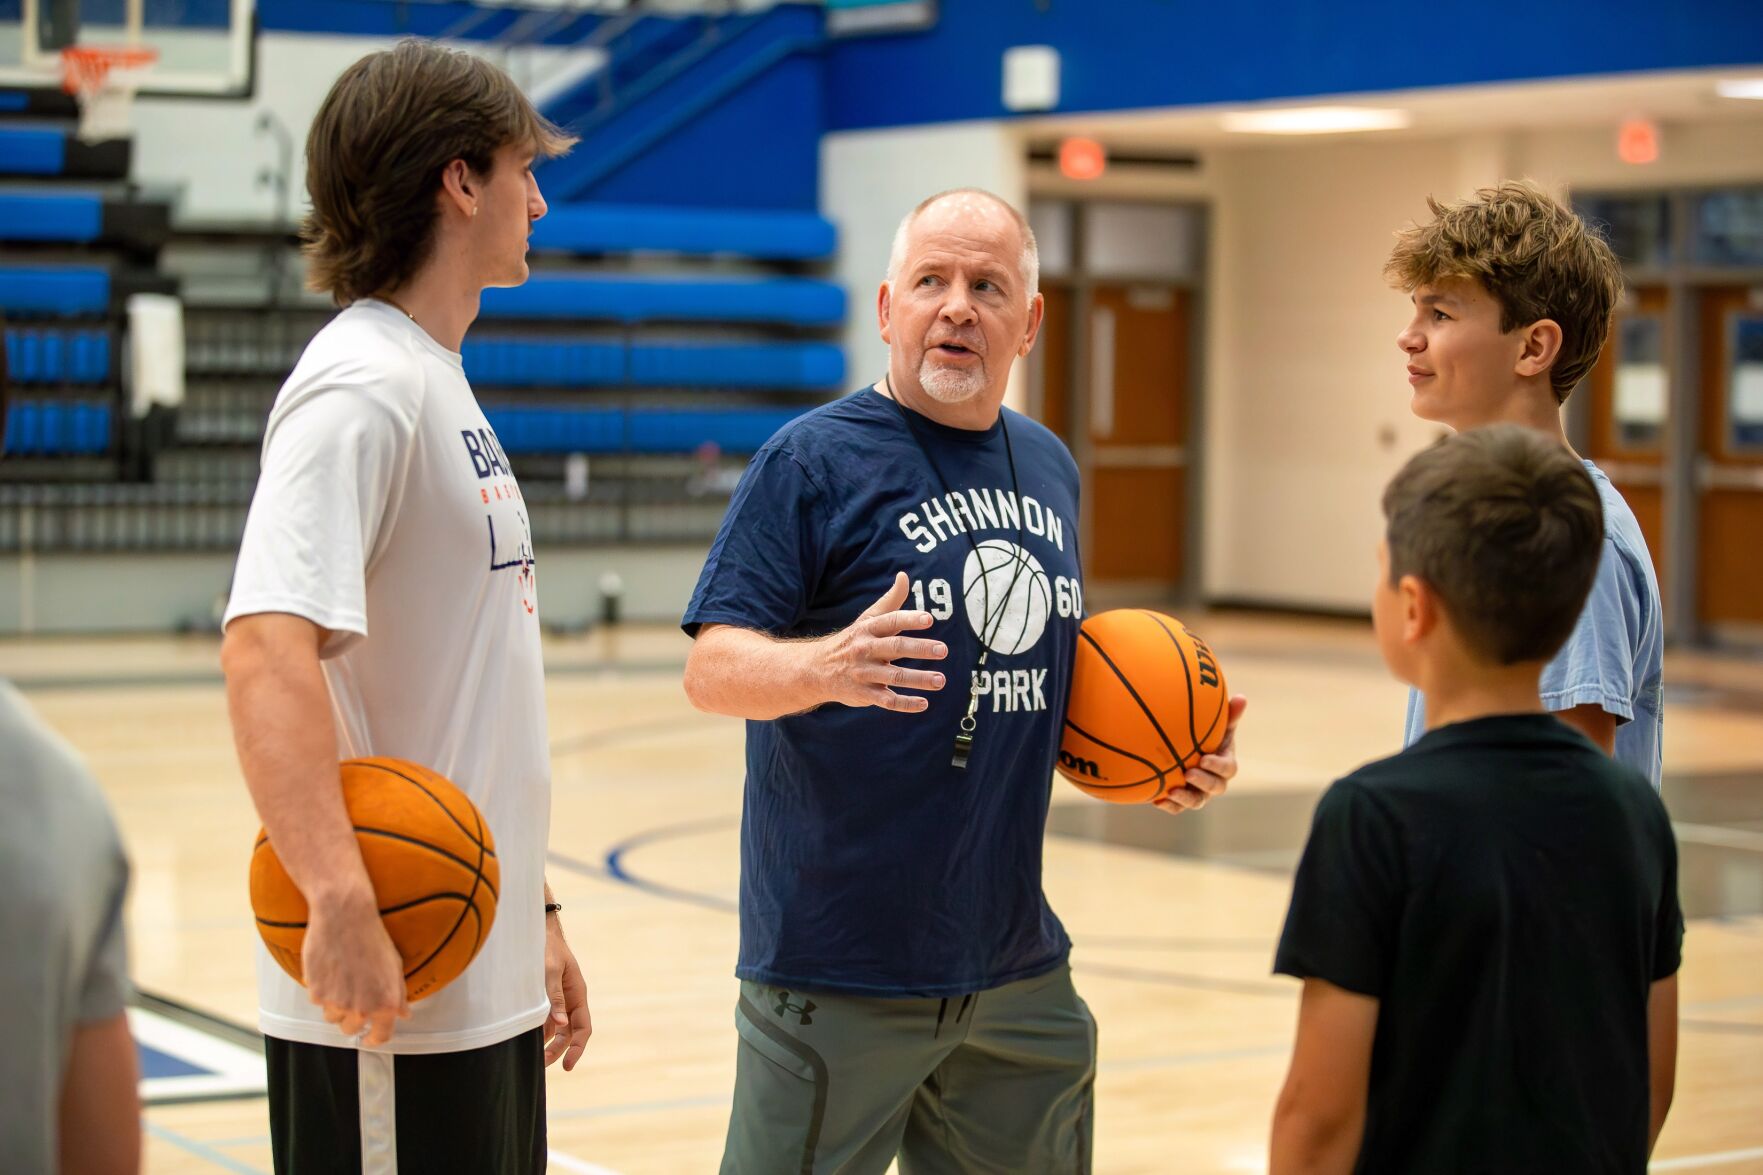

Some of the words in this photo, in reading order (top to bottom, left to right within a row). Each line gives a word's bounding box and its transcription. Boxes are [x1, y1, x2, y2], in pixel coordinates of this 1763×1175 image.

[461, 427, 515, 479] BA
[899, 487, 1064, 553] SHANNON
[911, 578, 954, 621] 19
[1054, 575, 1082, 620] 60
[971, 668, 1048, 713] PARK
